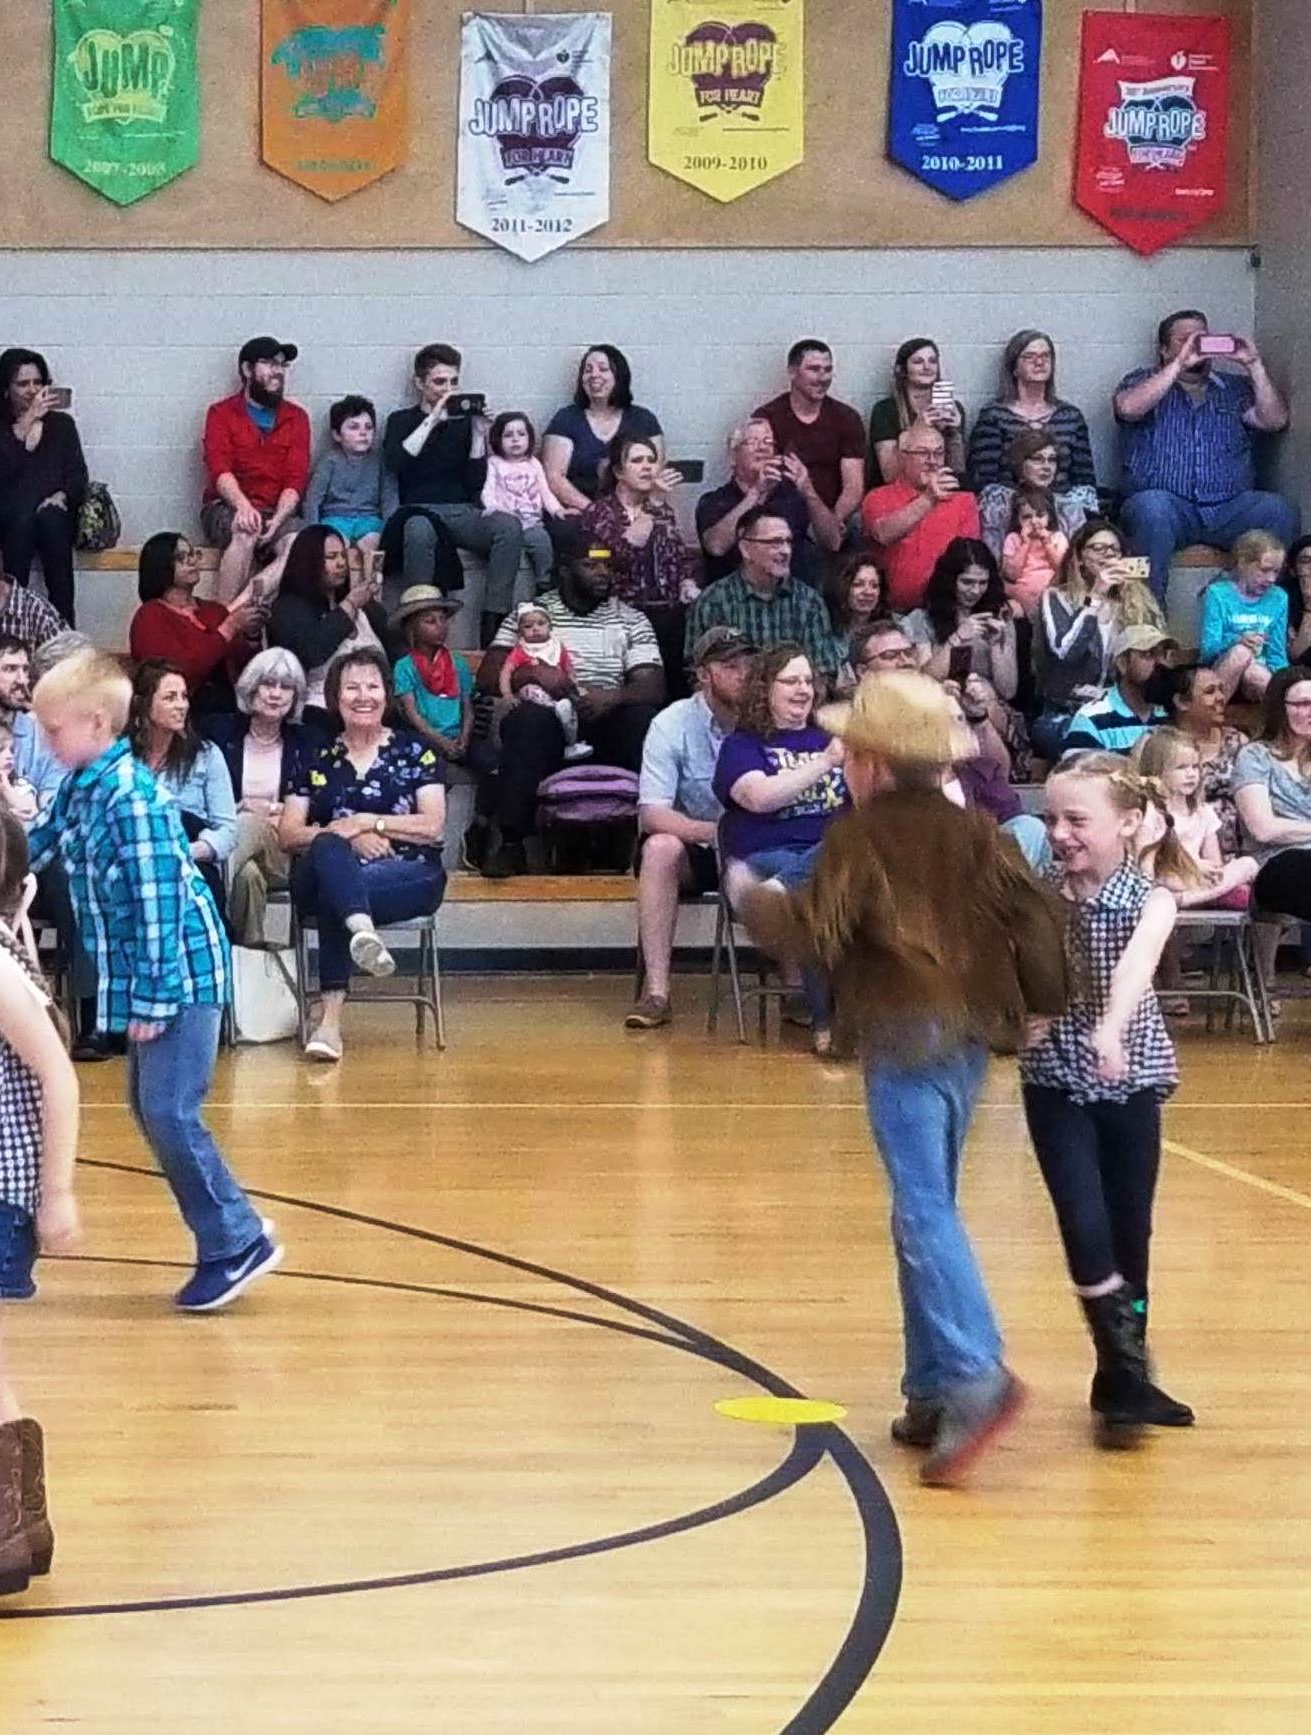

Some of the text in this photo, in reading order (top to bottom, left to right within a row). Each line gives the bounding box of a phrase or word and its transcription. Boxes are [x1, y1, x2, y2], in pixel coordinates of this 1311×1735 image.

[667, 38, 786, 79] JUMP ROPE
[905, 39, 1022, 77] JUMP ROPE
[699, 88, 761, 104] FOR HEART
[468, 94, 598, 138] JUMP ROPE
[1104, 108, 1206, 141] JUMP ROPE
[683, 155, 768, 171] 2009-2010
[921, 154, 1004, 171] 2010-2011
[491, 217, 573, 233] 2011-2012
